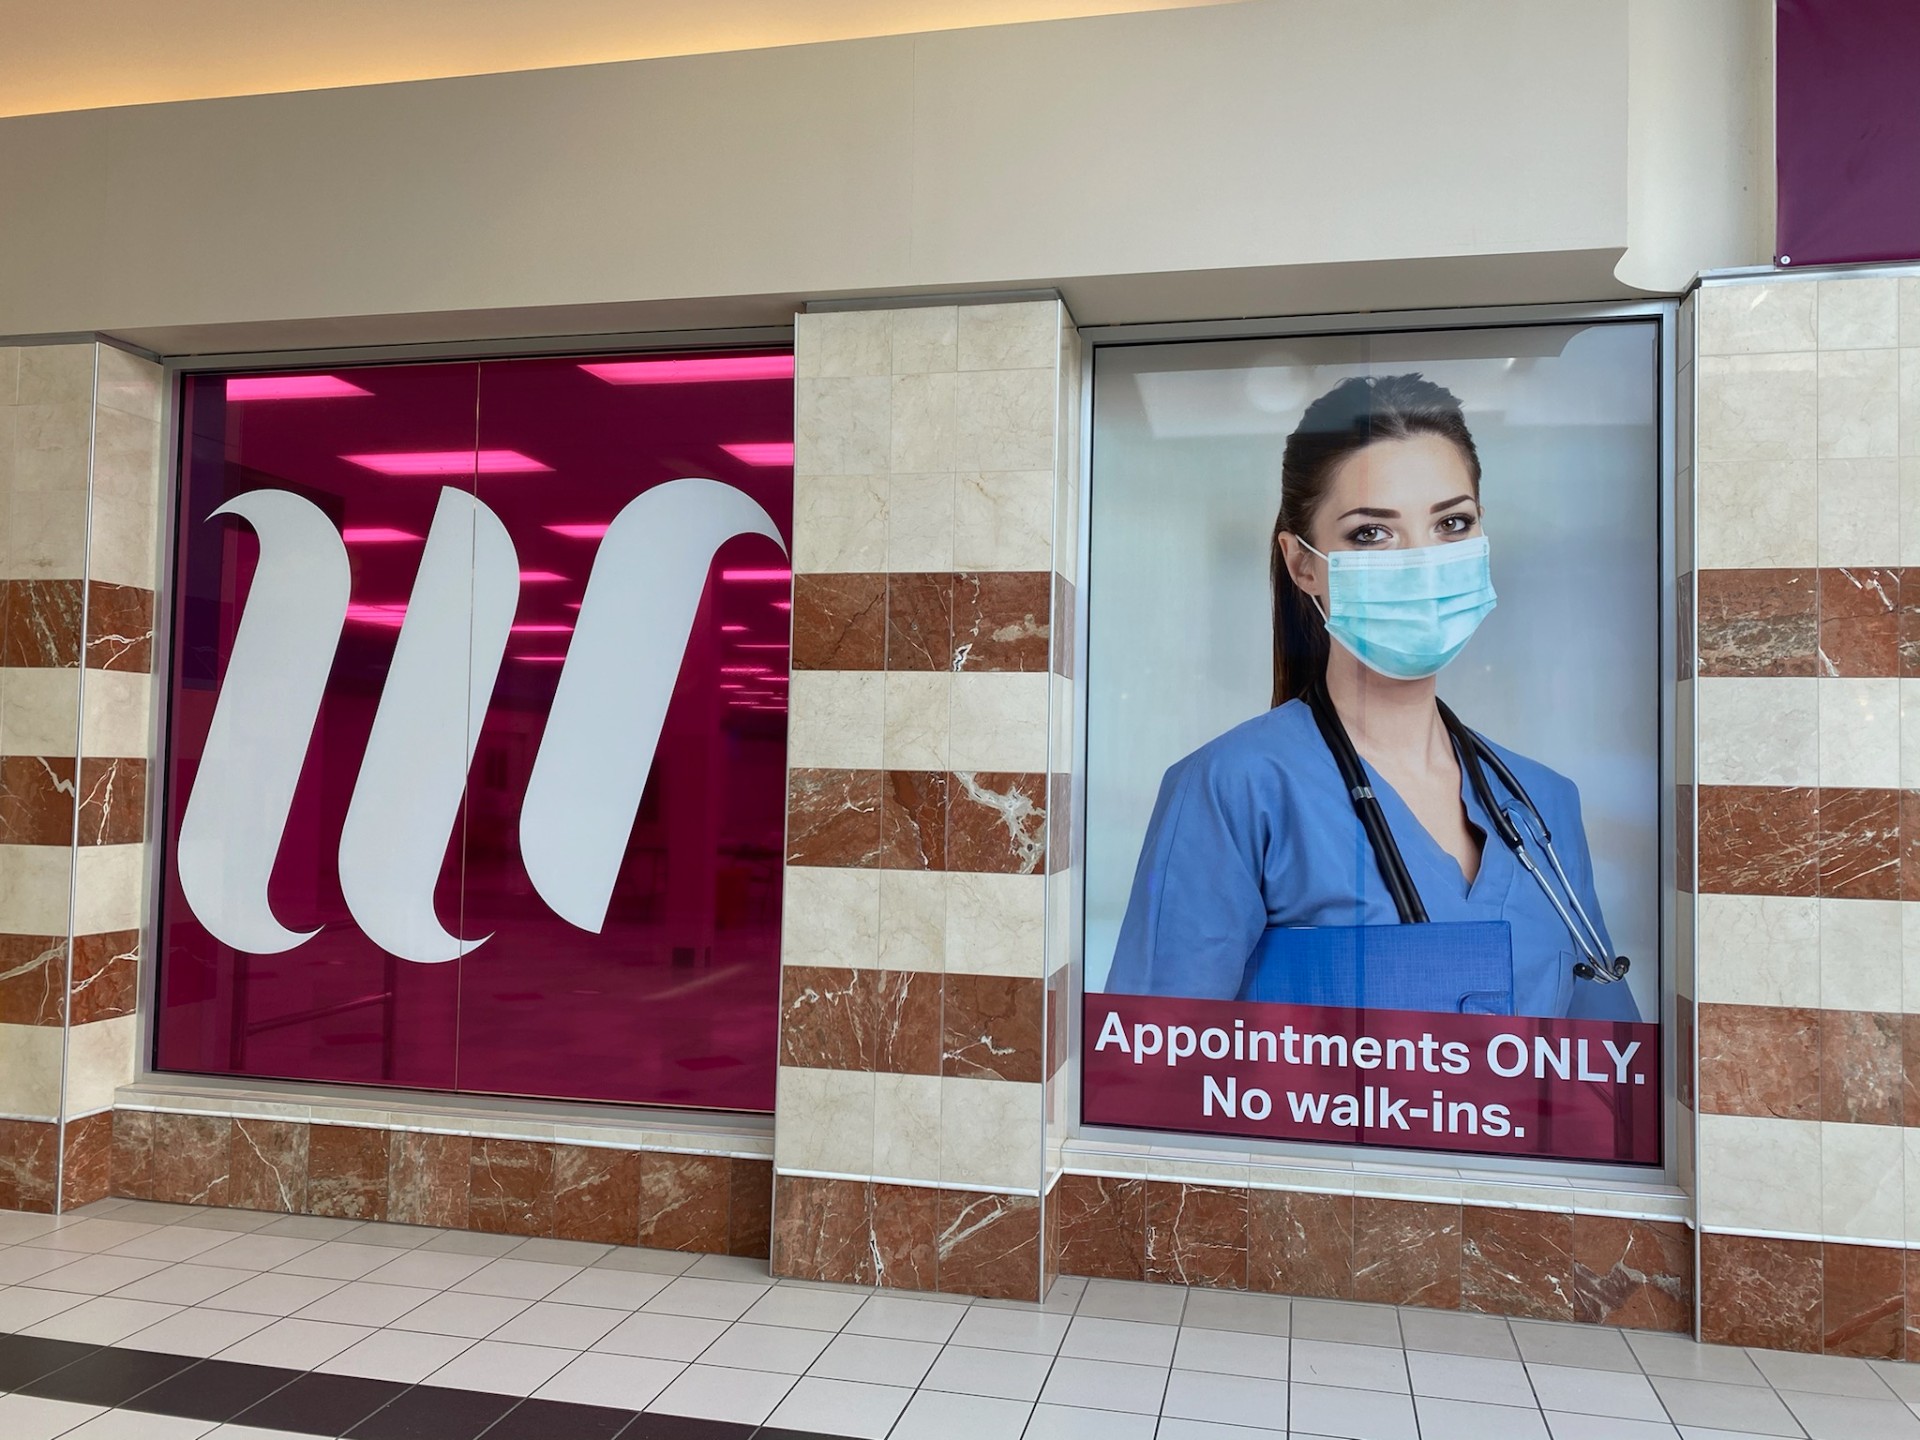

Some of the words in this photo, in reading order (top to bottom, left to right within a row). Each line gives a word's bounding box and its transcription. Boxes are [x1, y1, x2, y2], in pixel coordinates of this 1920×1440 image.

[1094, 1011, 1471, 1076] Appointments
[1486, 1033, 1646, 1086] ONLY.
[1203, 1075, 1273, 1121] No
[1286, 1085, 1526, 1139] walk-ins.
